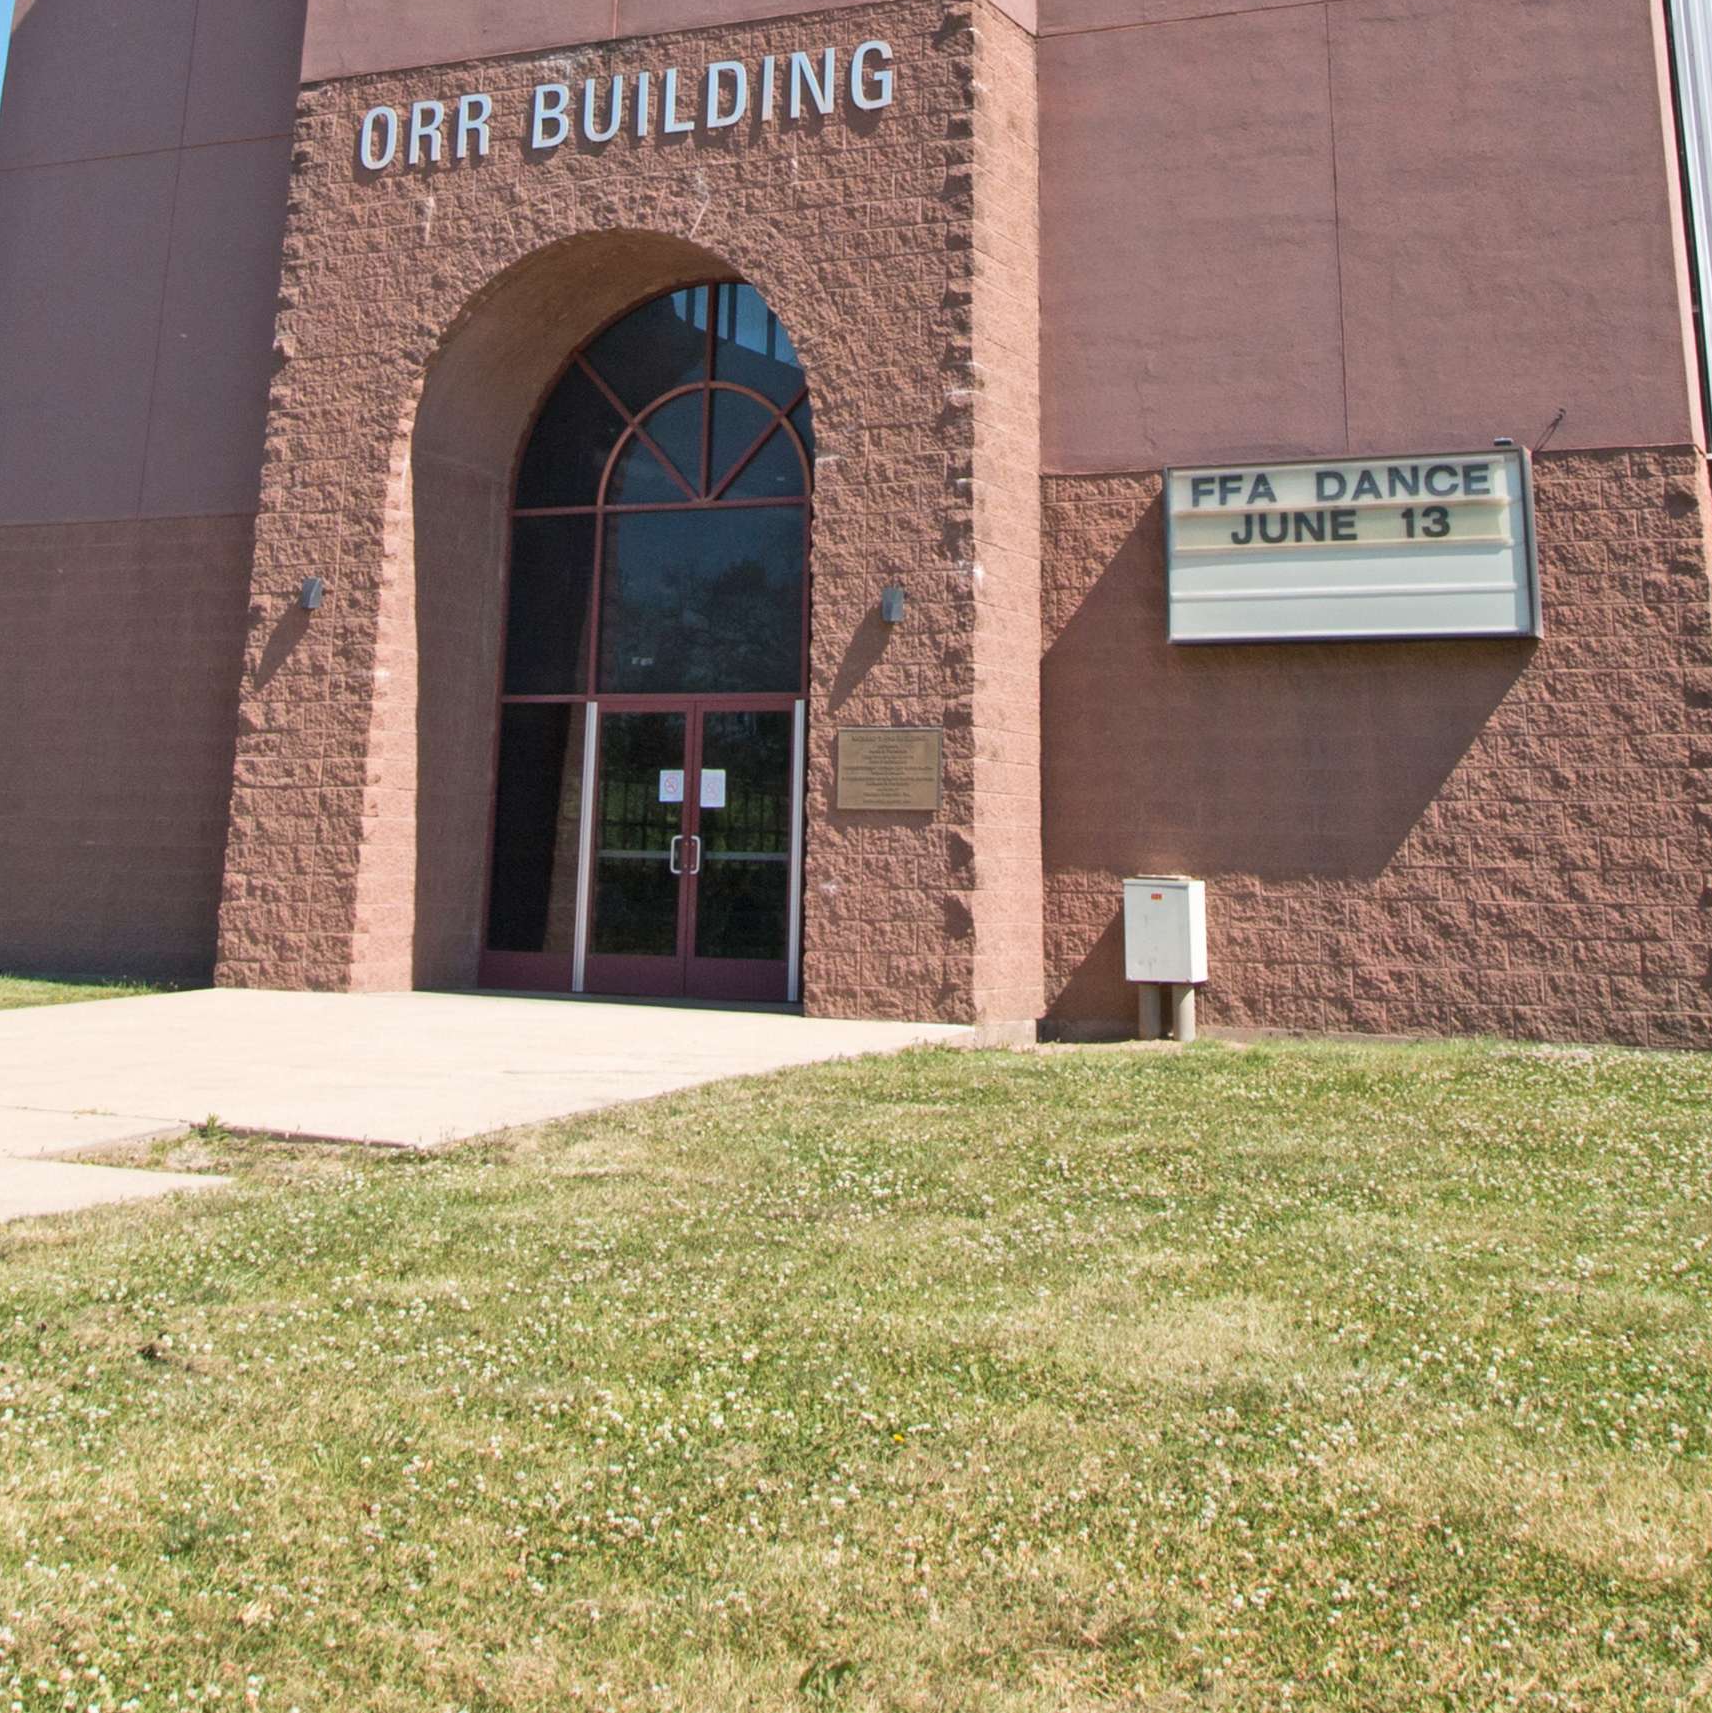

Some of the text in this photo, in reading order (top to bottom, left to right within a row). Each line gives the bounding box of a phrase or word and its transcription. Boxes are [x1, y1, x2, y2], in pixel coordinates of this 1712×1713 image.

[360, 40, 895, 170] ORR BUILDING
[1191, 463, 1491, 507] FFA DANCE
[1230, 505, 1451, 545] JUNE 13
